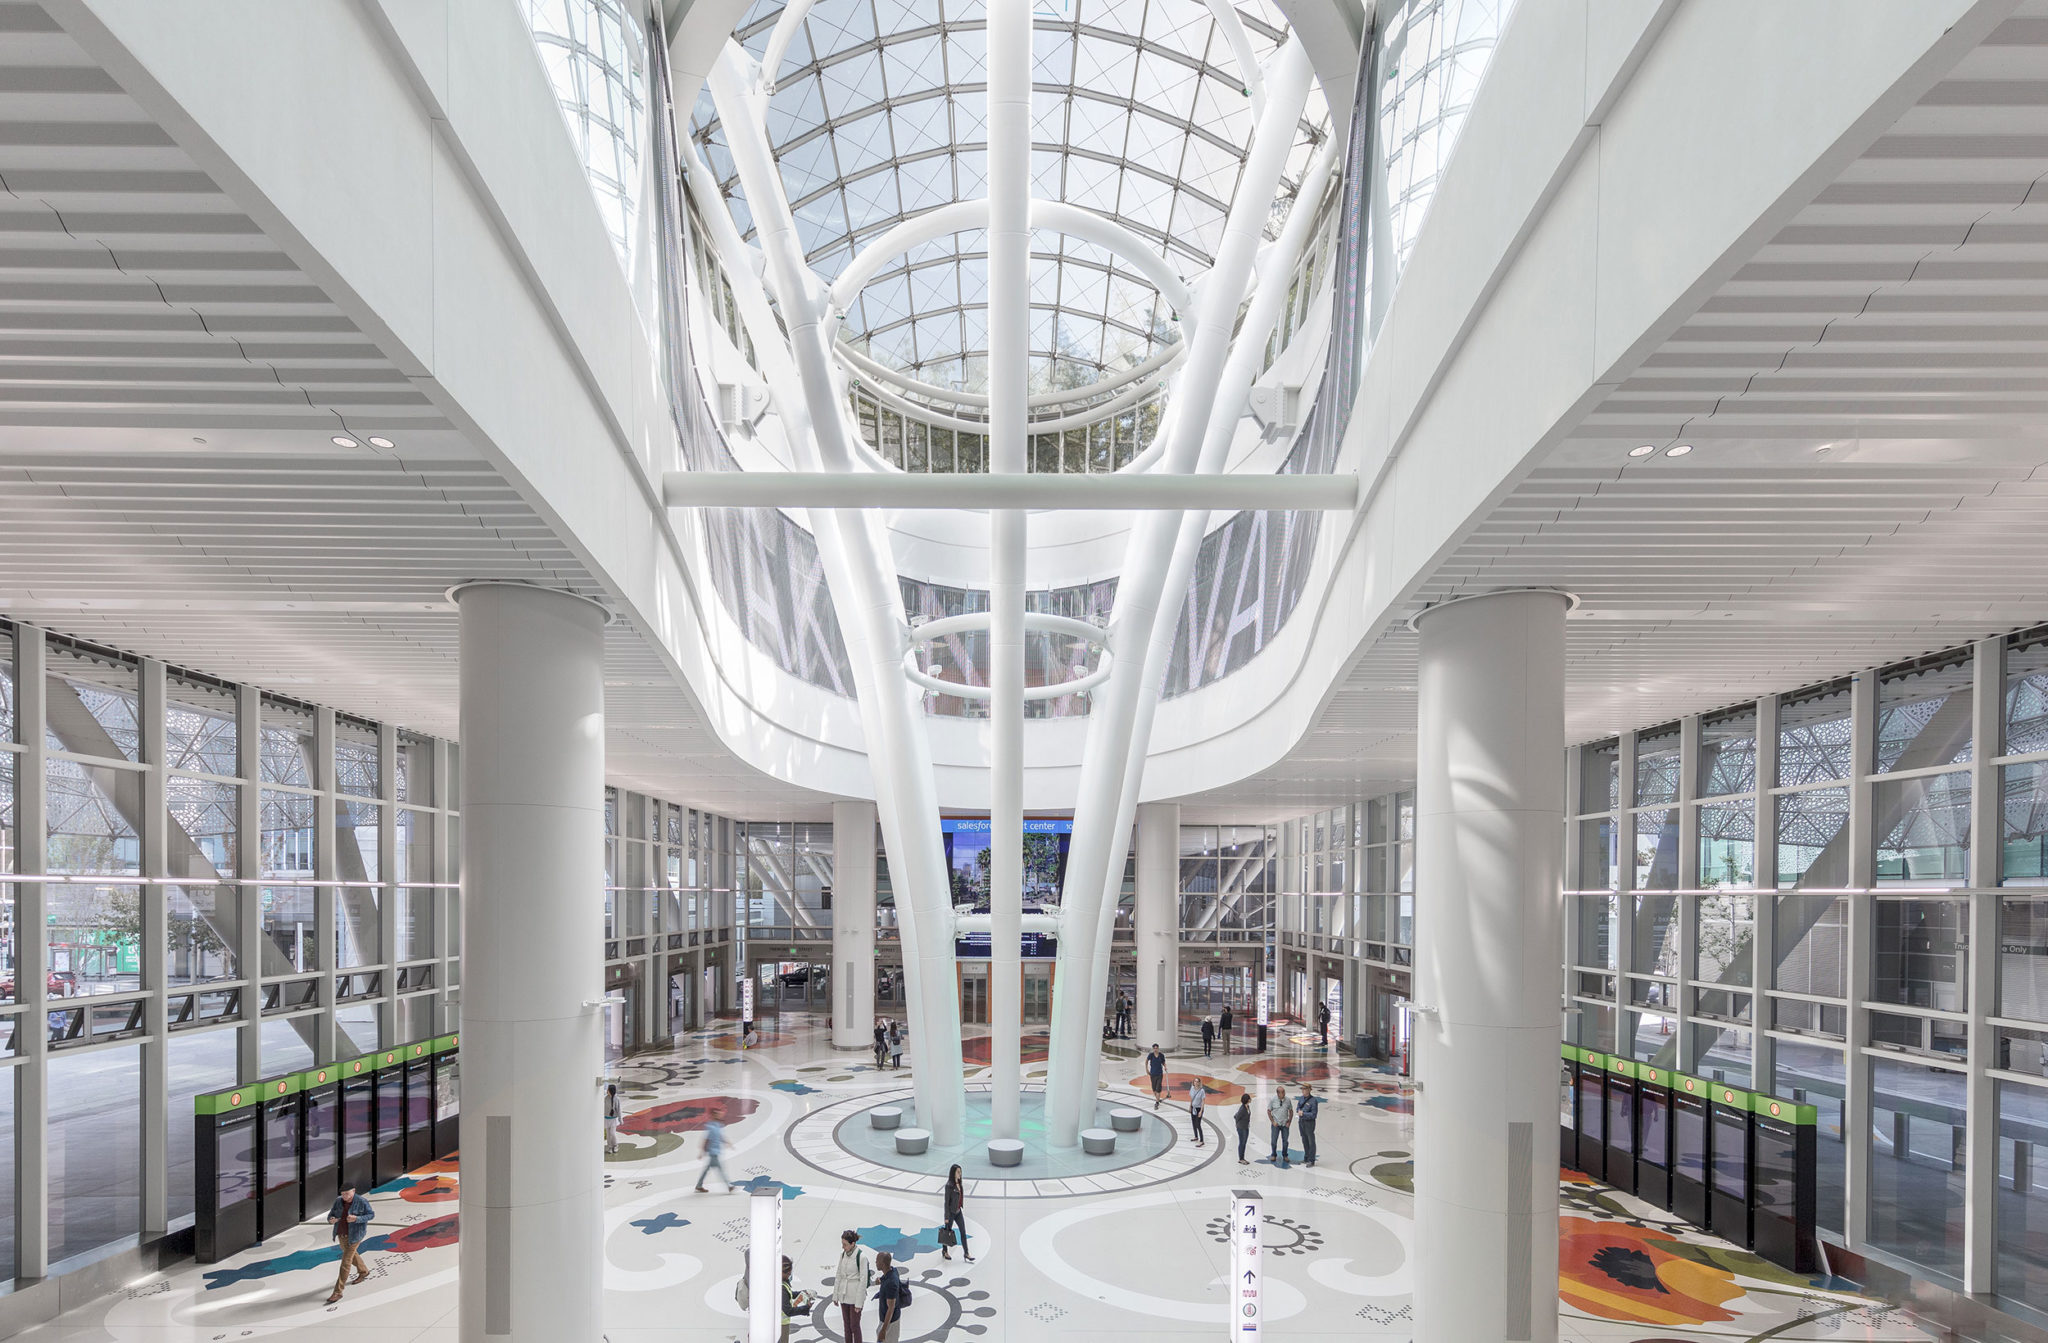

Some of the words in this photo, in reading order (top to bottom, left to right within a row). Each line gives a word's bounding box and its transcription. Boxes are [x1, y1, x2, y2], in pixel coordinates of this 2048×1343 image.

[957, 821, 992, 832] salesfor
[1029, 822, 1056, 831] center
[1953, 942, 1969, 951] Truc
[2009, 945, 2027, 954] Only
